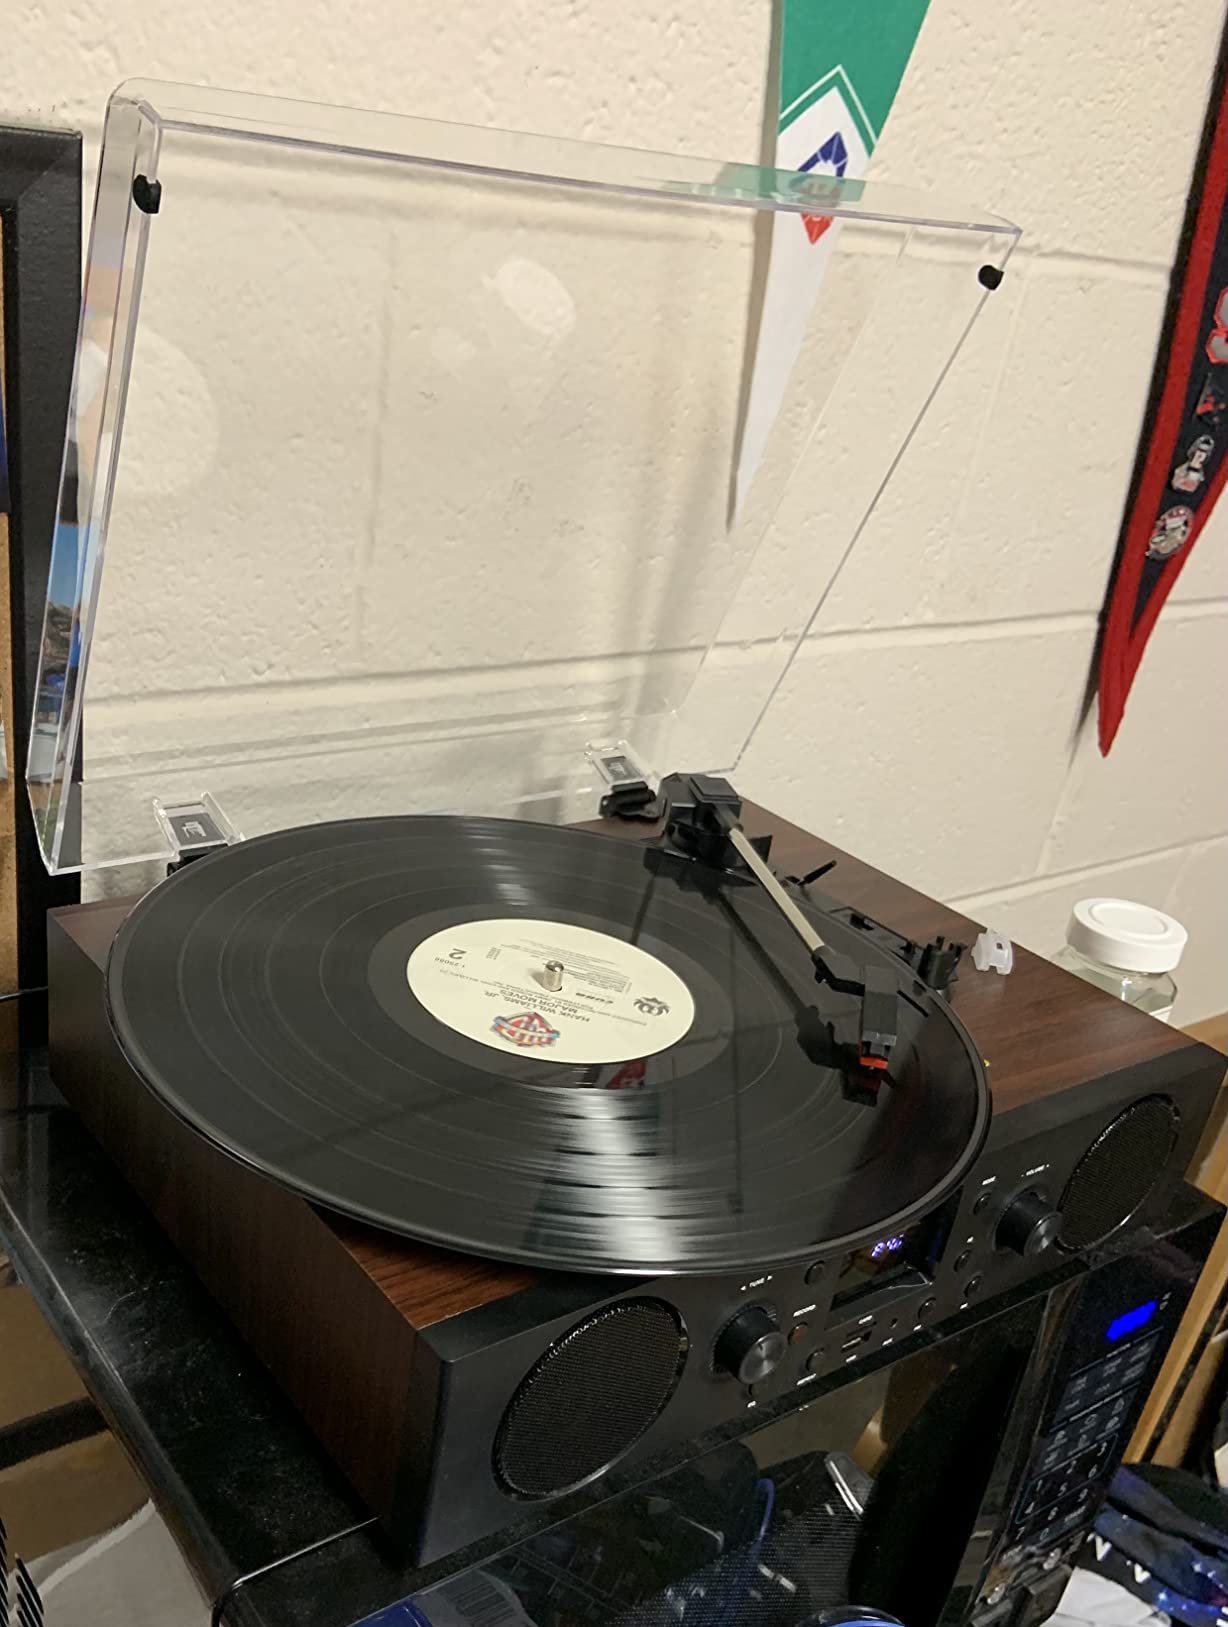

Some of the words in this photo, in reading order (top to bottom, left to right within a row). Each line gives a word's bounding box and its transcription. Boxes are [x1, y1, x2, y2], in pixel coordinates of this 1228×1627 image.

[448, 948, 467, 960] 2
[499, 989, 537, 1007] MOVES
[537, 998, 579, 1014] MAJOR
[558, 1010, 591, 1023] HANK
